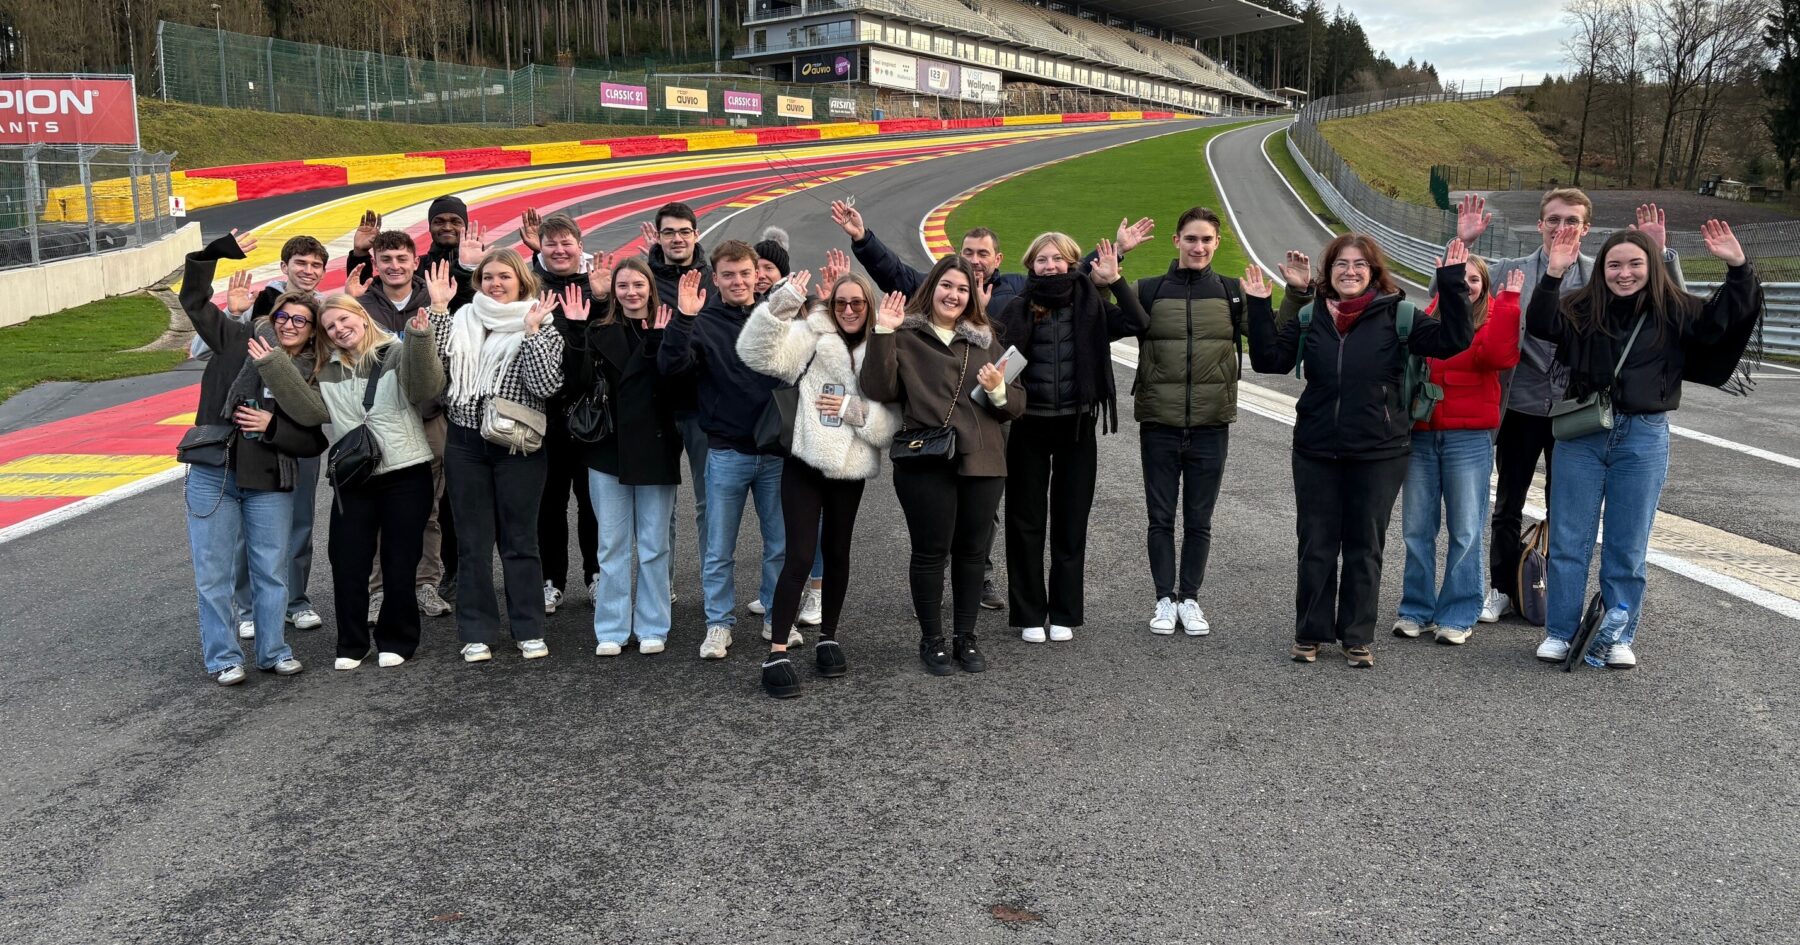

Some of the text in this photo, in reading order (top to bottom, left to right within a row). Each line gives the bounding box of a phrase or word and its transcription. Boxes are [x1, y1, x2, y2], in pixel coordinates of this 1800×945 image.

[930, 69, 941, 79] 123
[967, 79, 996, 91] Wallonia
[605, 88, 644, 102] CLASSIC 21
[727, 96, 752, 107] CLASSIC
